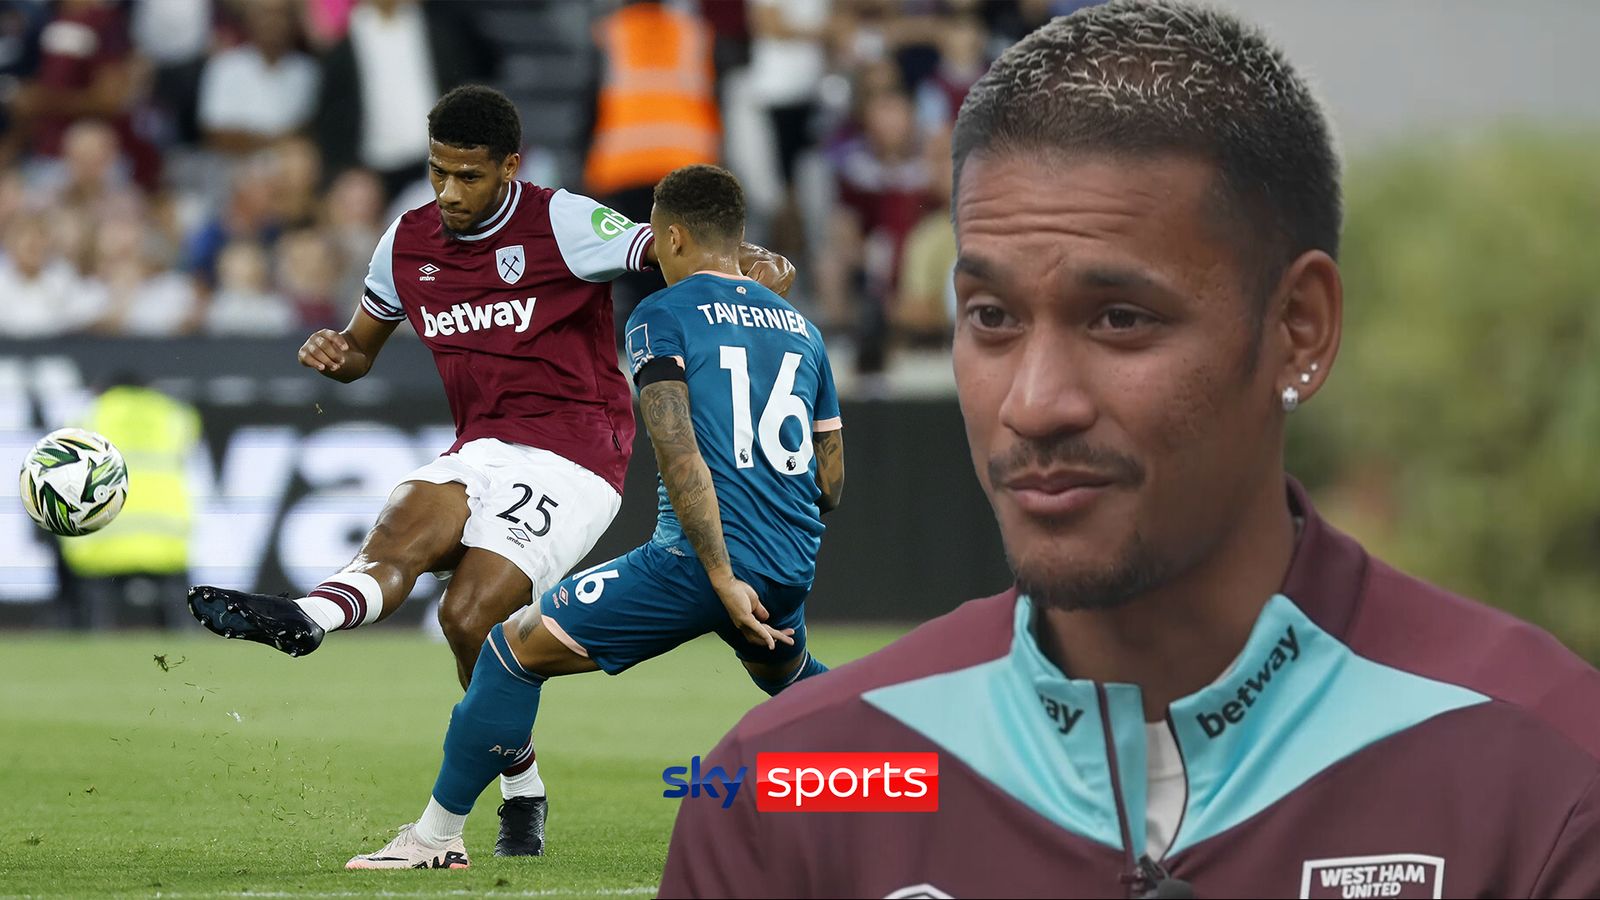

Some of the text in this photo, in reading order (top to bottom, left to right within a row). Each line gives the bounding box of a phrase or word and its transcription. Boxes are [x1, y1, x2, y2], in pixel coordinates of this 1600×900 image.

[420, 297, 537, 338] betway
[697, 302, 810, 338] TAVERNIER
[719, 345, 814, 476] 16
[495, 483, 559, 537] 25
[506, 535, 525, 549] umbro
[1196, 624, 1301, 739] betway
[1320, 863, 1425, 888] WEST HAM
[1342, 881, 1401, 899] UNITED
